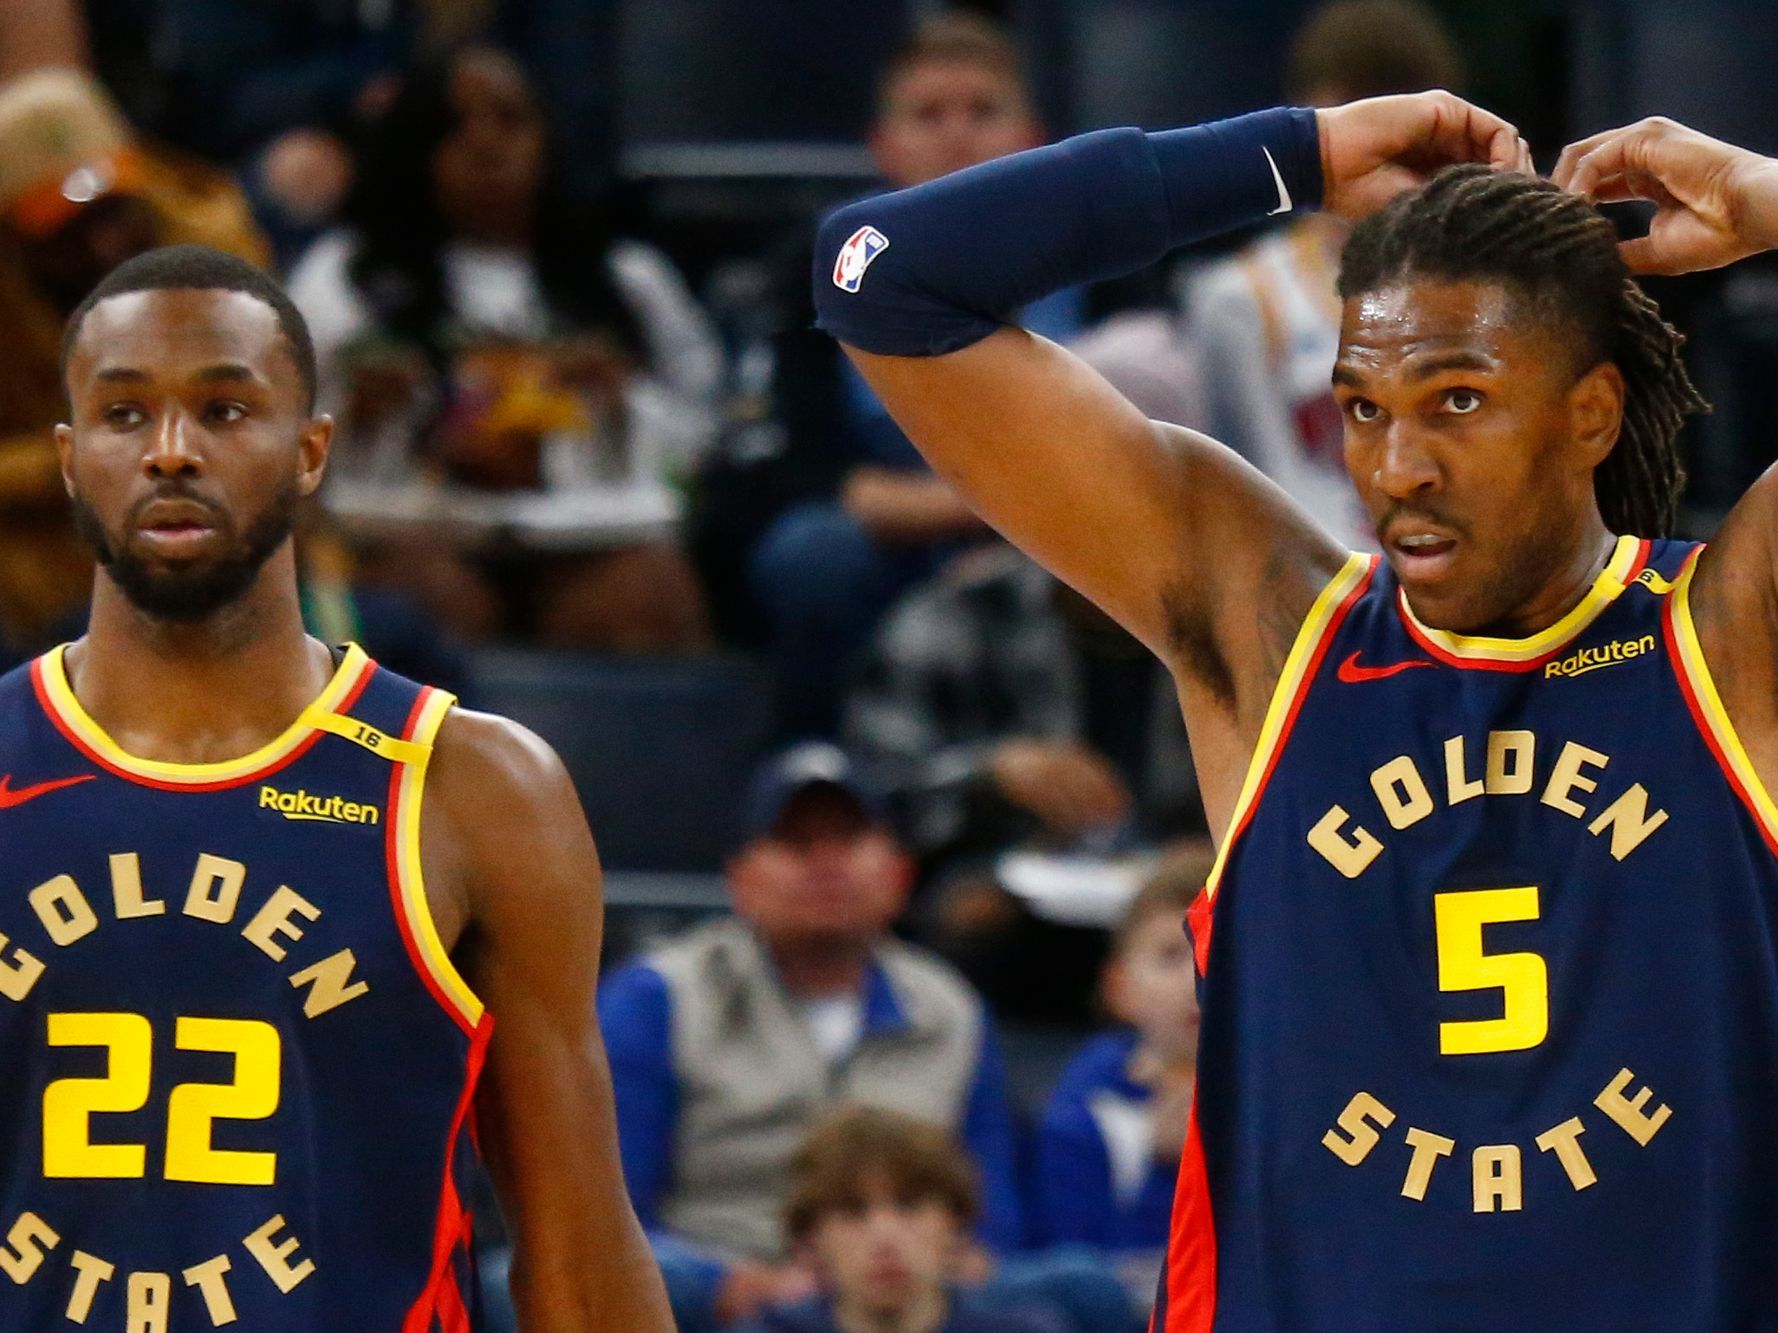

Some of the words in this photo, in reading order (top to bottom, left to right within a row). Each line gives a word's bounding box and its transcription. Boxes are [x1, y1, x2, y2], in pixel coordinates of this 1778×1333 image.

[1544, 632, 1655, 679] Rakuten
[259, 786, 379, 825] Rakuten
[354, 726, 382, 748] 16
[1306, 729, 1670, 878] GOLDEN
[0, 852, 369, 1019] GOLDEN
[1434, 886, 1549, 1055] 5
[42, 1012, 281, 1185] 22
[1321, 1067, 1673, 1213] STATE
